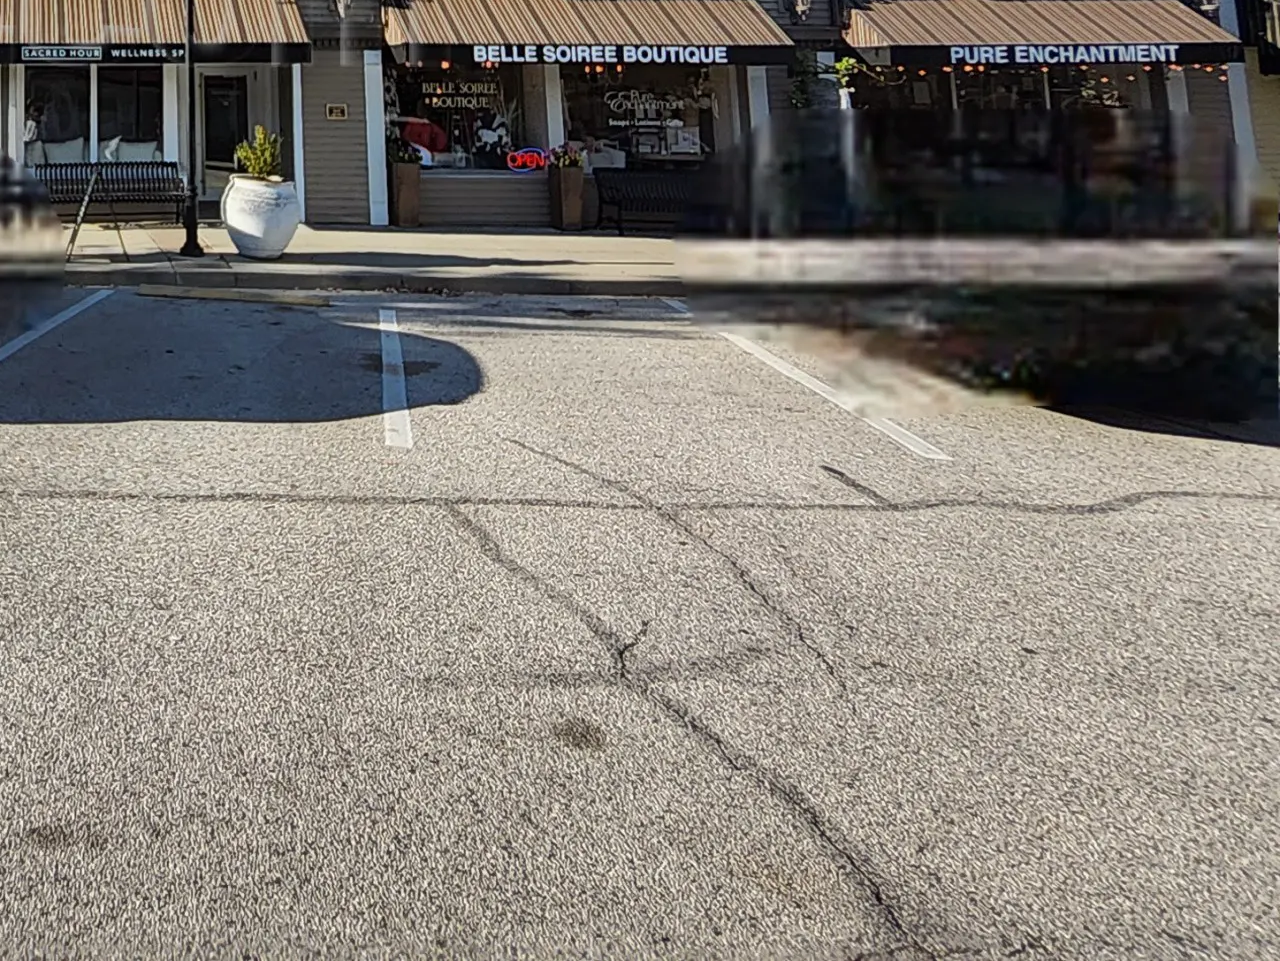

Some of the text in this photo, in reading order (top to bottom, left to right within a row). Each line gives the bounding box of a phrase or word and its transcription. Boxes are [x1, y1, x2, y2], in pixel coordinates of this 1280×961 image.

[24, 49, 66, 58] SACRED
[70, 49, 100, 58] HOUR
[111, 49, 167, 58] WELLNESS
[473, 46, 728, 64] BELLE SOIREE BOUTIQUE
[950, 44, 1179, 64] PURE ENCHANTMENT
[422, 82, 498, 94] BELLE SOIREE
[432, 96, 490, 109] BOUTIQUE
[507, 152, 545, 167] OPEN
